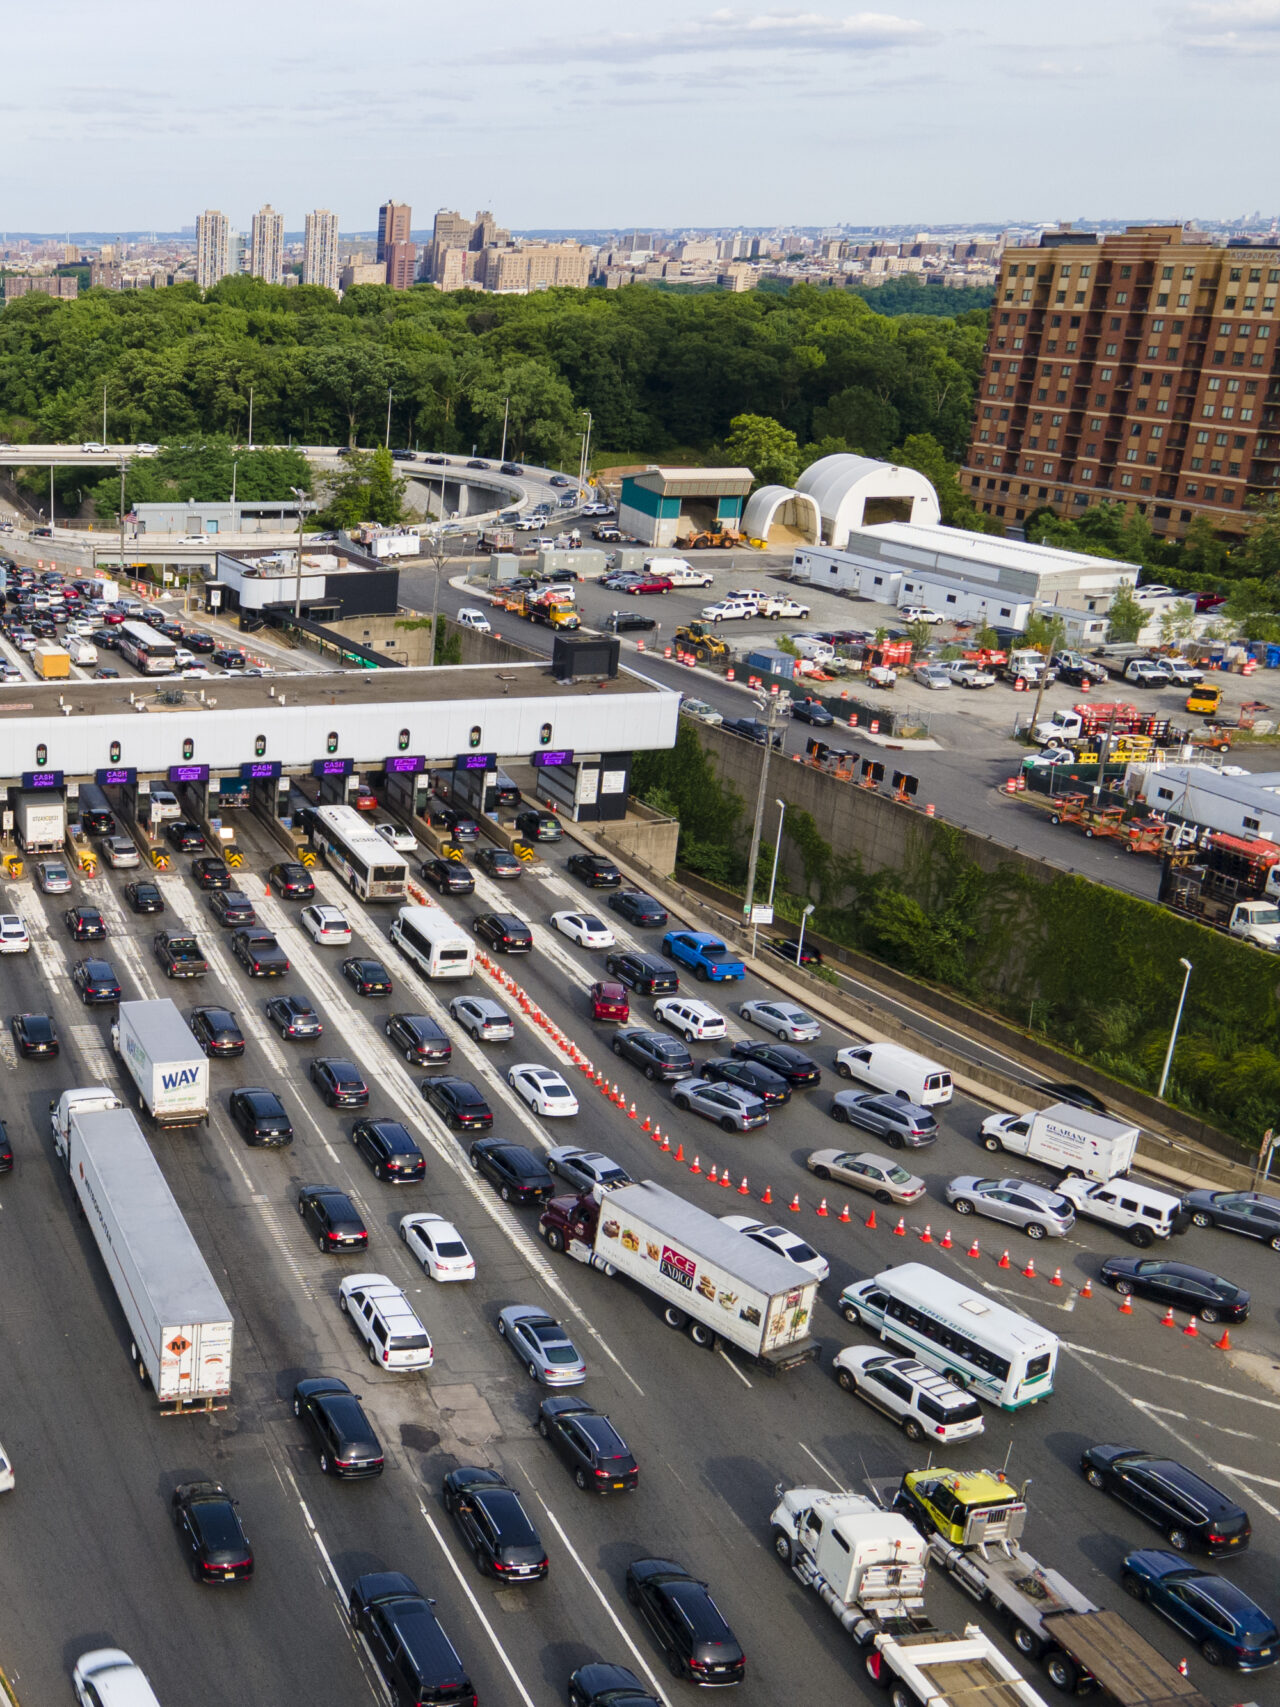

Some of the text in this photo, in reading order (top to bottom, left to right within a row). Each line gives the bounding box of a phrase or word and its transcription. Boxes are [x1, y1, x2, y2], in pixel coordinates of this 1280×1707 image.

[162, 1067, 199, 1089] WAY
[1046, 1123, 1086, 1142] GUARANI
[661, 1260, 693, 1288] ENDICO
[663, 1250, 695, 1275] ACE
[918, 1305, 977, 1340] EXPRESS SERVICE
[171, 1340, 186, 1350] M
